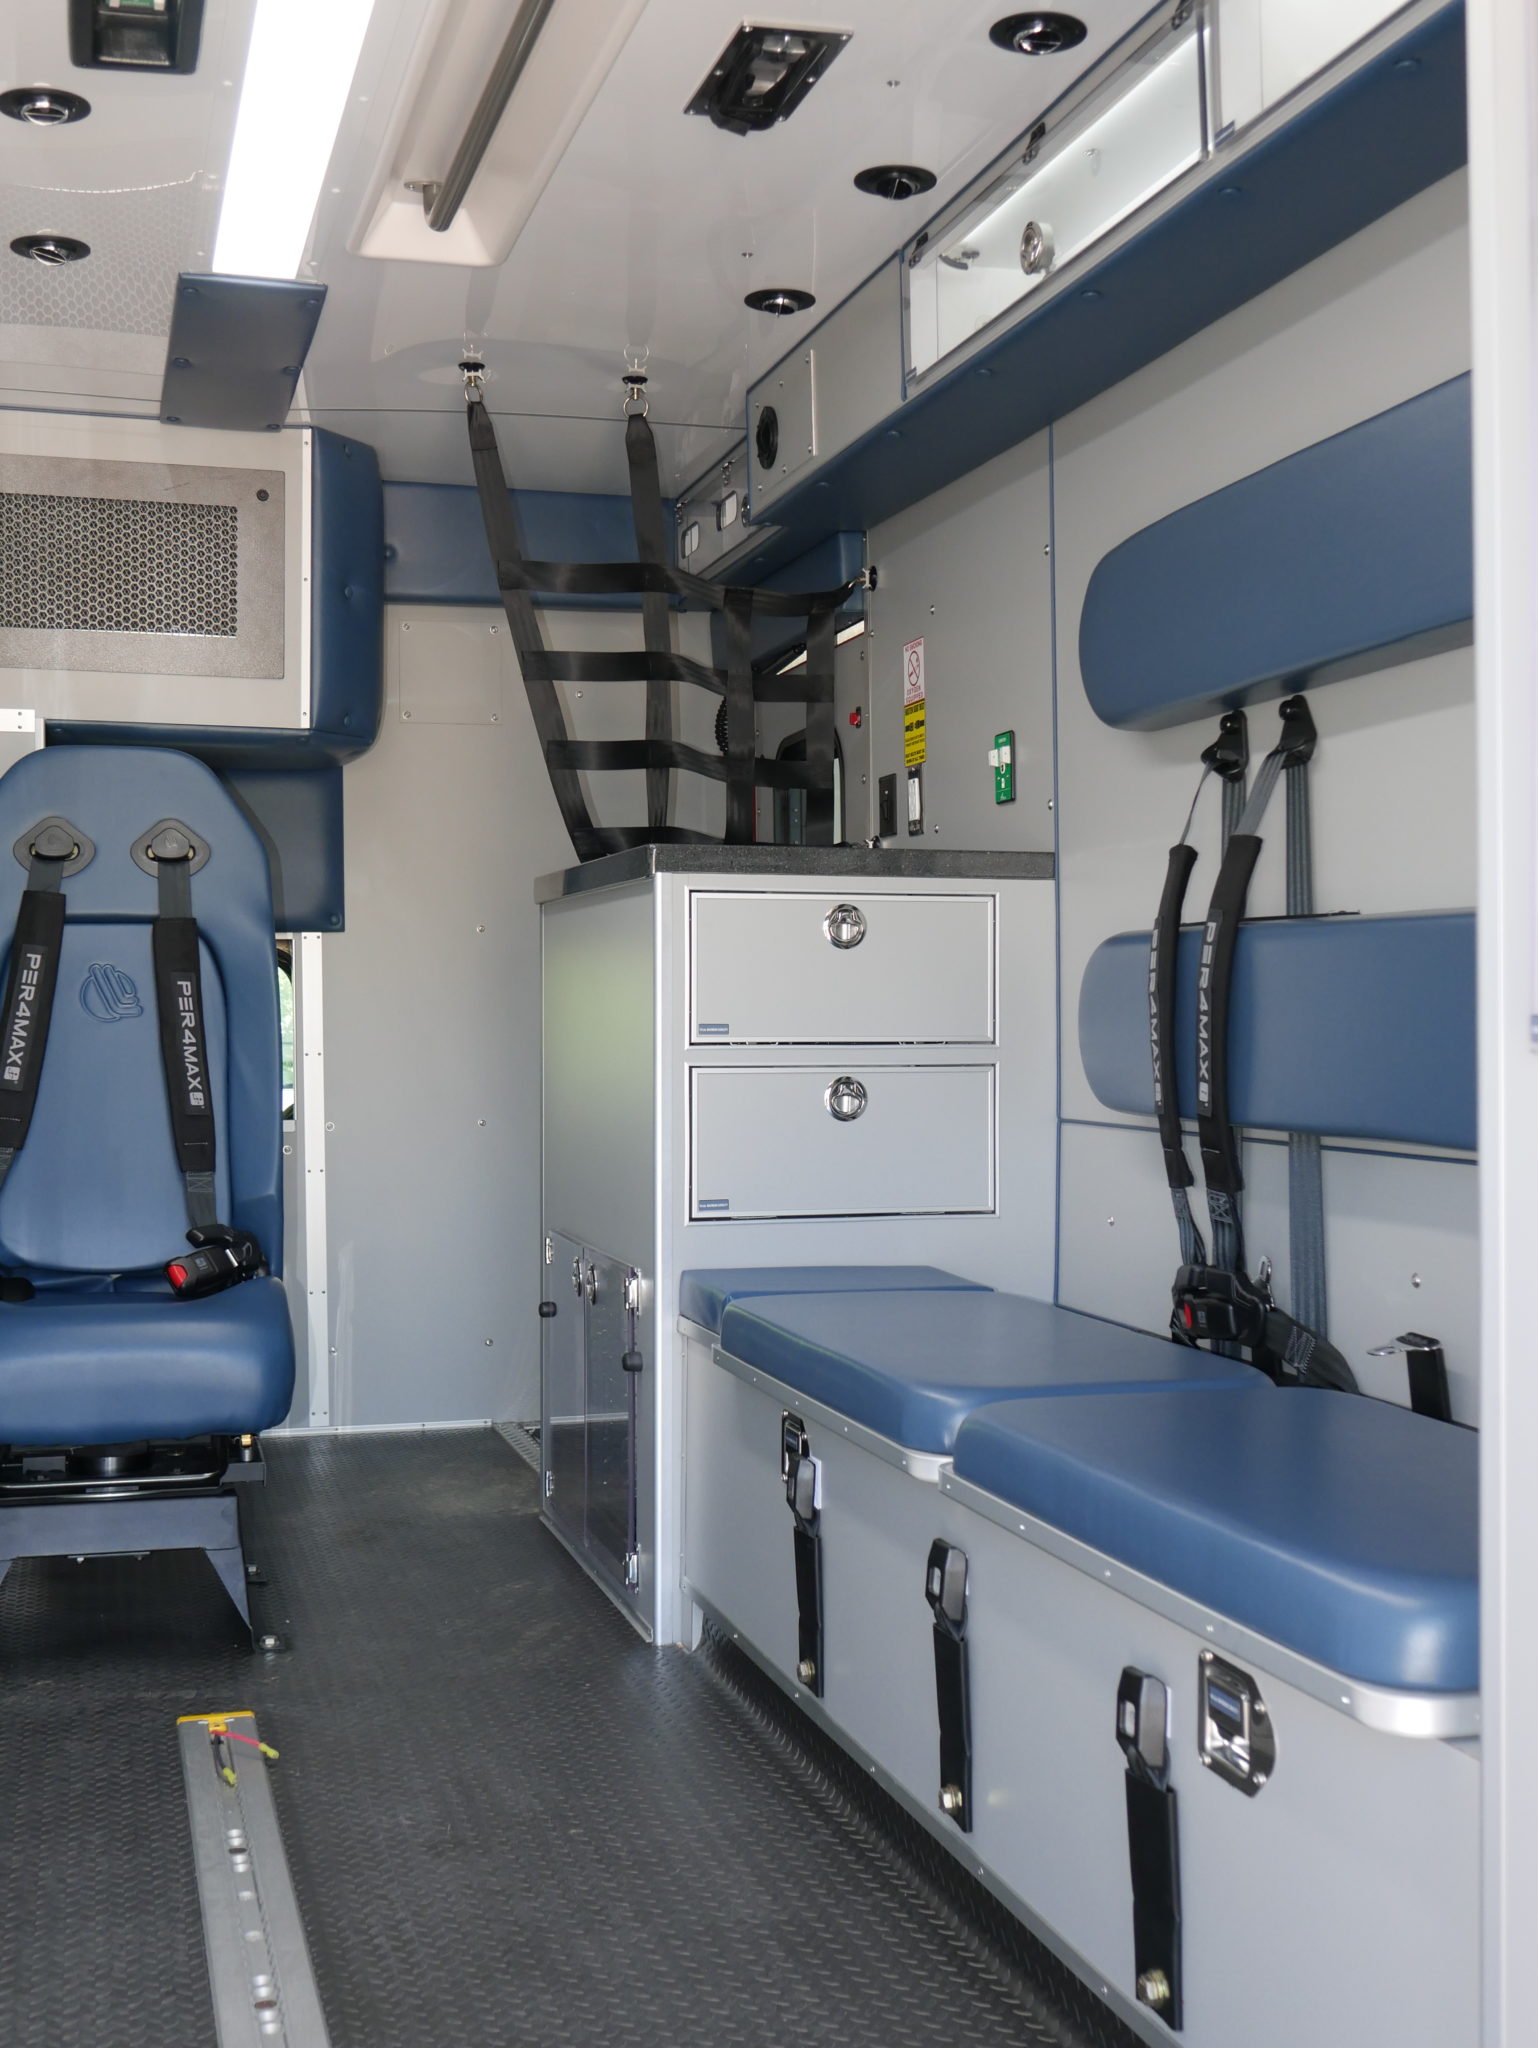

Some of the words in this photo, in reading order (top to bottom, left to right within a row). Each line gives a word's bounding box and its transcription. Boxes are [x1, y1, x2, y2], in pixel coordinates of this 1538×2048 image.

[6, 953, 41, 1065] PER4MAX
[178, 981, 203, 1091] PER4MAX
[1199, 922, 1217, 1080] PER4MAX
